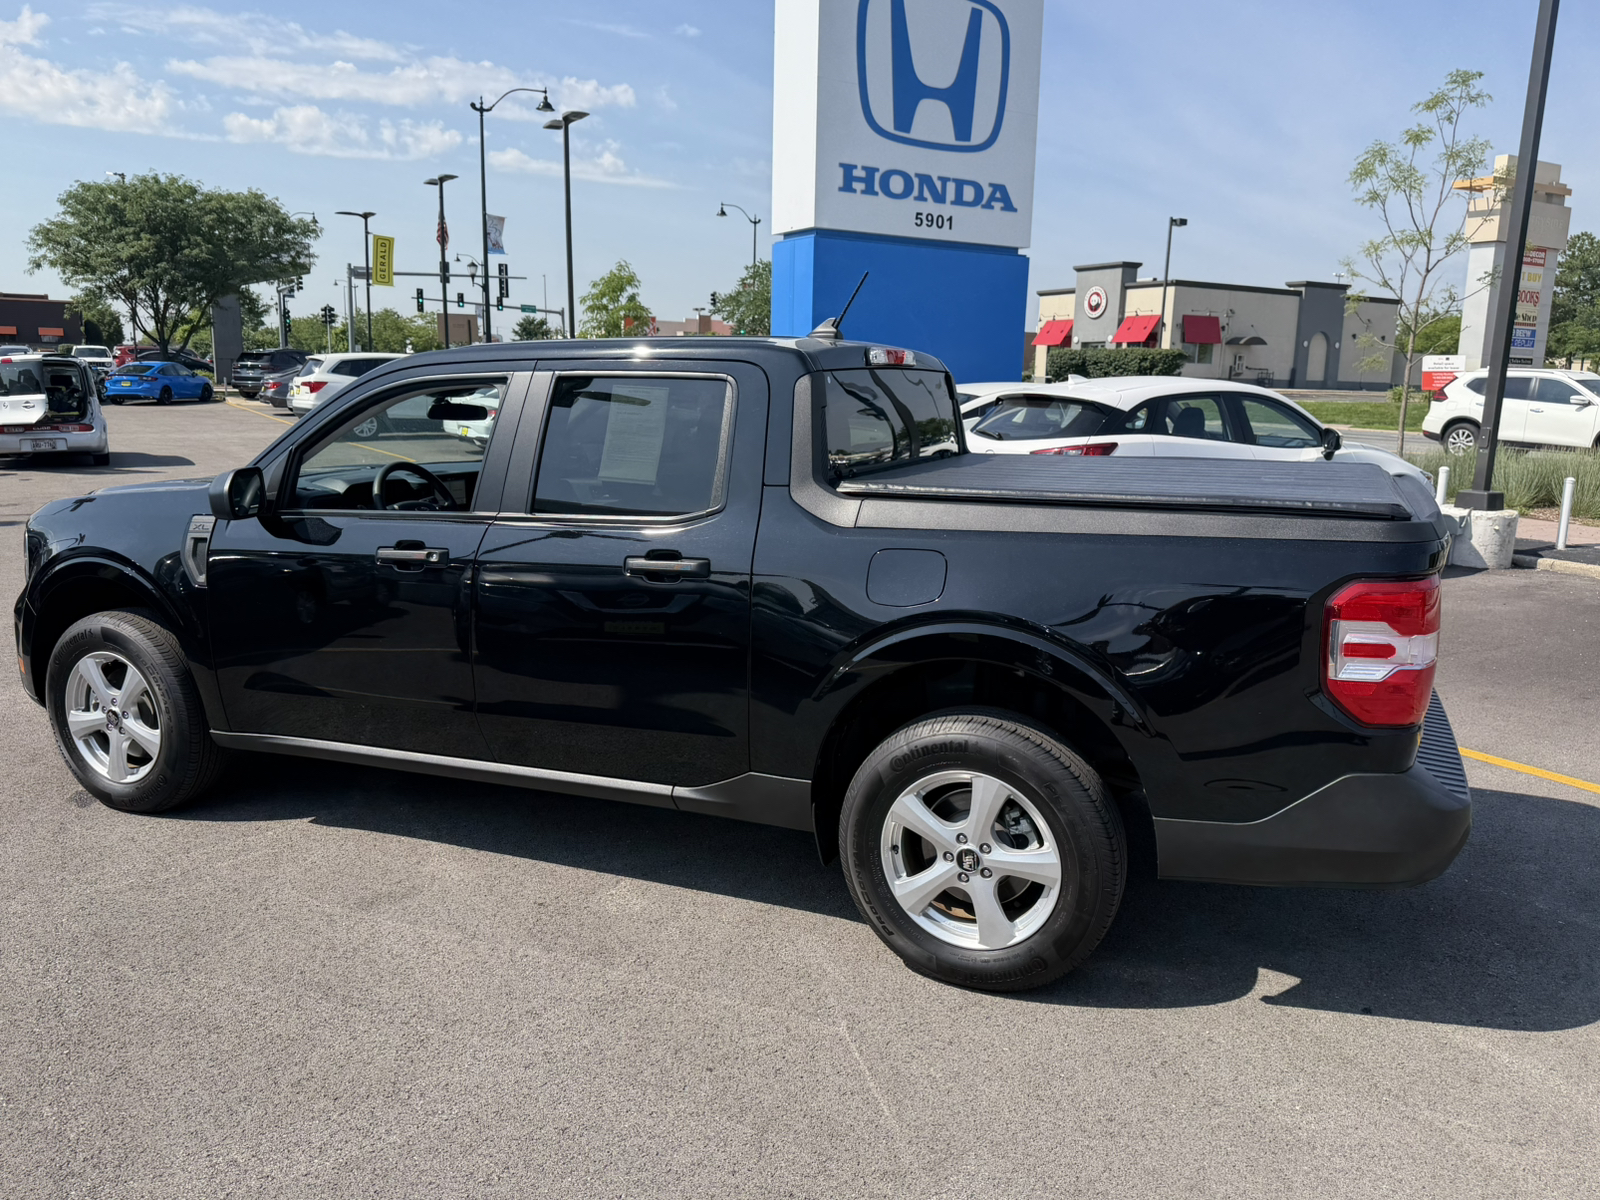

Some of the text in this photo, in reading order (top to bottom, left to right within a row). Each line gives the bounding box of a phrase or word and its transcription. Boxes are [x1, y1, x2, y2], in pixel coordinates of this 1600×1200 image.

[838, 162, 1018, 213] HONDA
[914, 211, 954, 231] 5901
[379, 241, 387, 279] GERALD
[1527, 271, 1542, 283] BUY
[192, 523, 210, 531] XL
[889, 739, 970, 773] Continental
